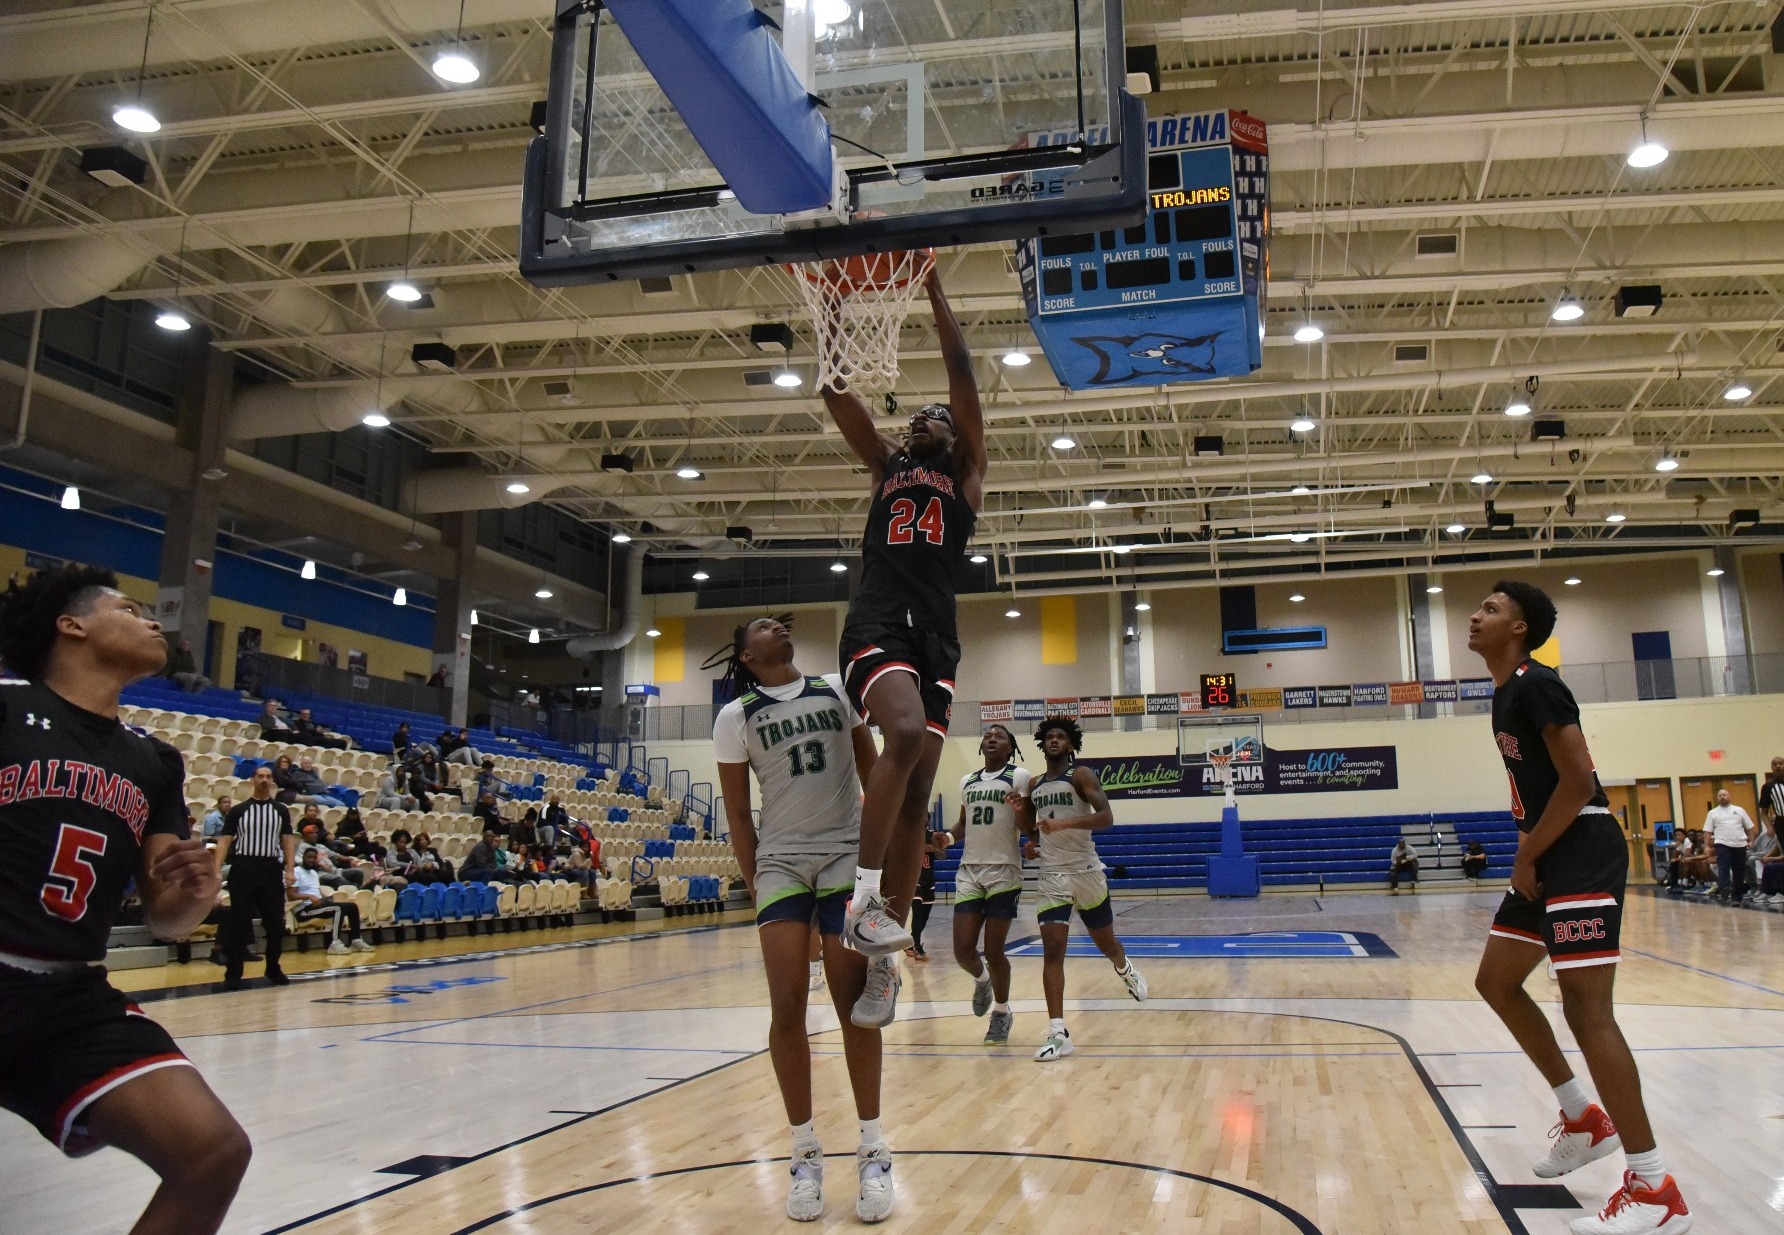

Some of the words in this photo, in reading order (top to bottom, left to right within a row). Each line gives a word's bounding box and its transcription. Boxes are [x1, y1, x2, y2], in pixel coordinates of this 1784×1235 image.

[1148, 112, 1226, 148] ARENA
[1151, 186, 1231, 209] TROJANS
[1202, 240, 1234, 253] FOULS
[1103, 249, 1140, 263] PLAYER
[1145, 246, 1170, 259] FOUL
[1041, 257, 1072, 270] FOULS
[1204, 281, 1237, 294] SCORE
[1121, 289, 1156, 302] MATCH
[1044, 298, 1076, 310] SCORE
[887, 497, 944, 546] 24
[1206, 675, 1232, 686] 14:31
[1285, 690, 1314, 698] GARRETT
[1354, 687, 1385, 695] HARFORD
[1424, 684, 1456, 692] MONTGOMERY
[1467, 689, 1487, 697] OWLS
[1208, 686, 1229, 704] 26
[1324, 696, 1347, 704] HAWKS
[1148, 704, 1178, 712] SKIPJACKS
[1288, 698, 1313, 706] LAKERS
[756, 708, 843, 751] TROJANS
[787, 740, 827, 778] 13
[1306, 752, 1347, 772] 600+
[1100, 761, 1185, 785] Celebration!
[1350, 768, 1380, 776] sporting
[1233, 782, 1265, 790] HARFORD
[966, 789, 1006, 805] TROJANS
[1034, 792, 1073, 811] TROJANS
[972, 806, 994, 826] 20
[40, 822, 108, 923] 5
[1553, 918, 1606, 943] BCCC
